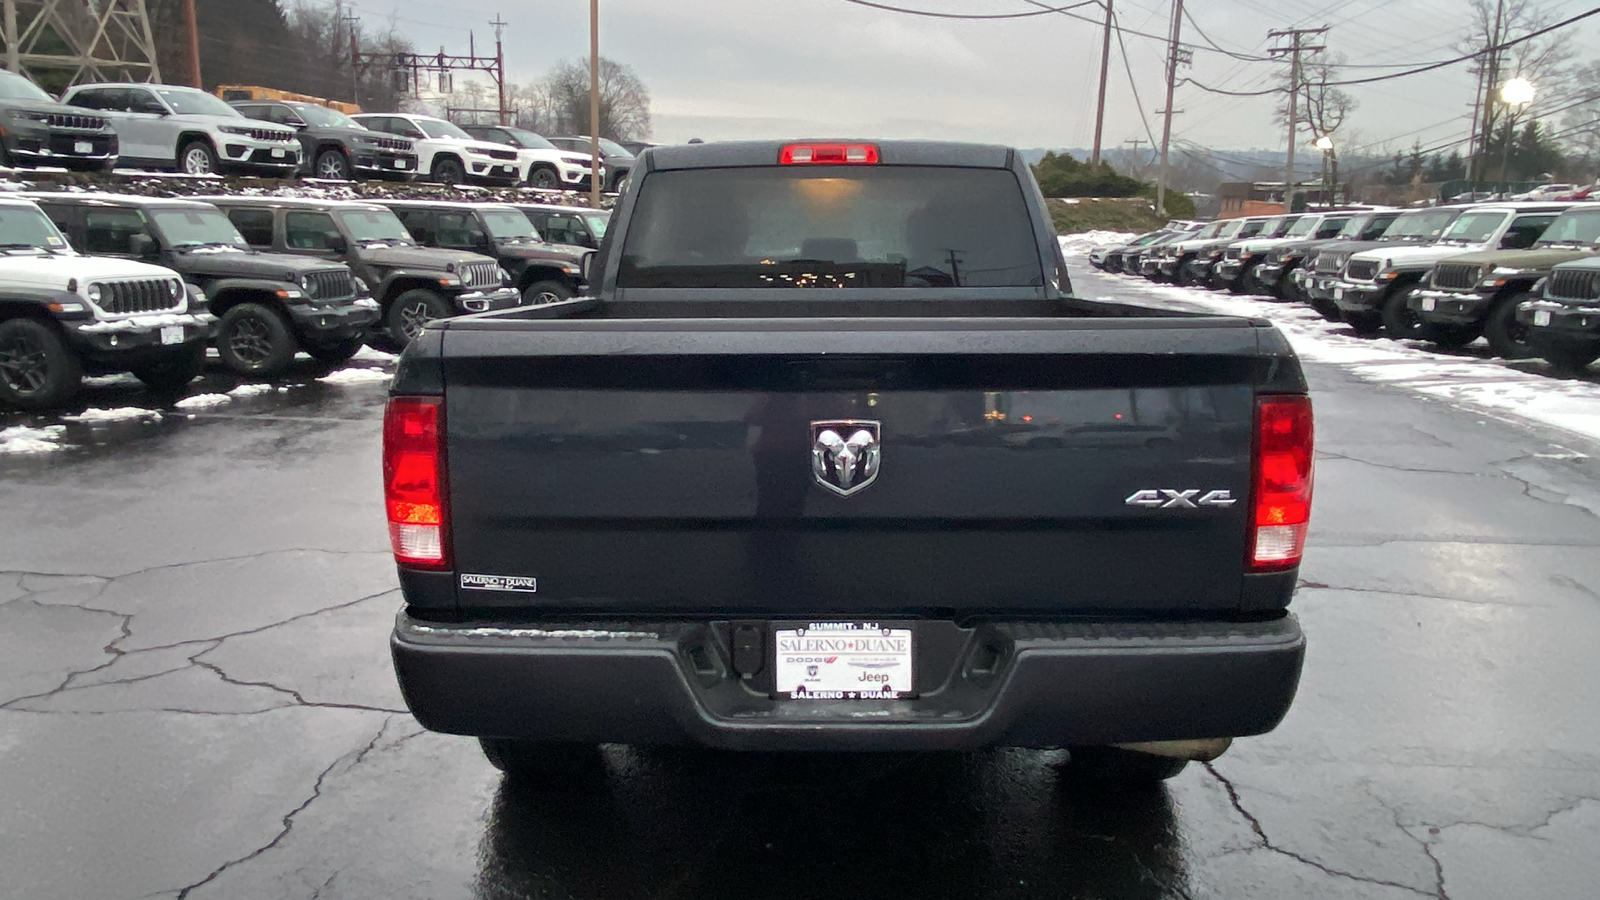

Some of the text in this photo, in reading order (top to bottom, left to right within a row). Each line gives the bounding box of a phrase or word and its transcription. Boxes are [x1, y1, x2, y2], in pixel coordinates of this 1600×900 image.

[463, 575, 499, 585] SALERNO
[506, 578, 534, 587] DUANE
[862, 622, 879, 630] NJ
[779, 639, 907, 652] SALERNO DUANE
[858, 671, 889, 684] Jeep
[790, 691, 899, 699] SALERNO DUANE
